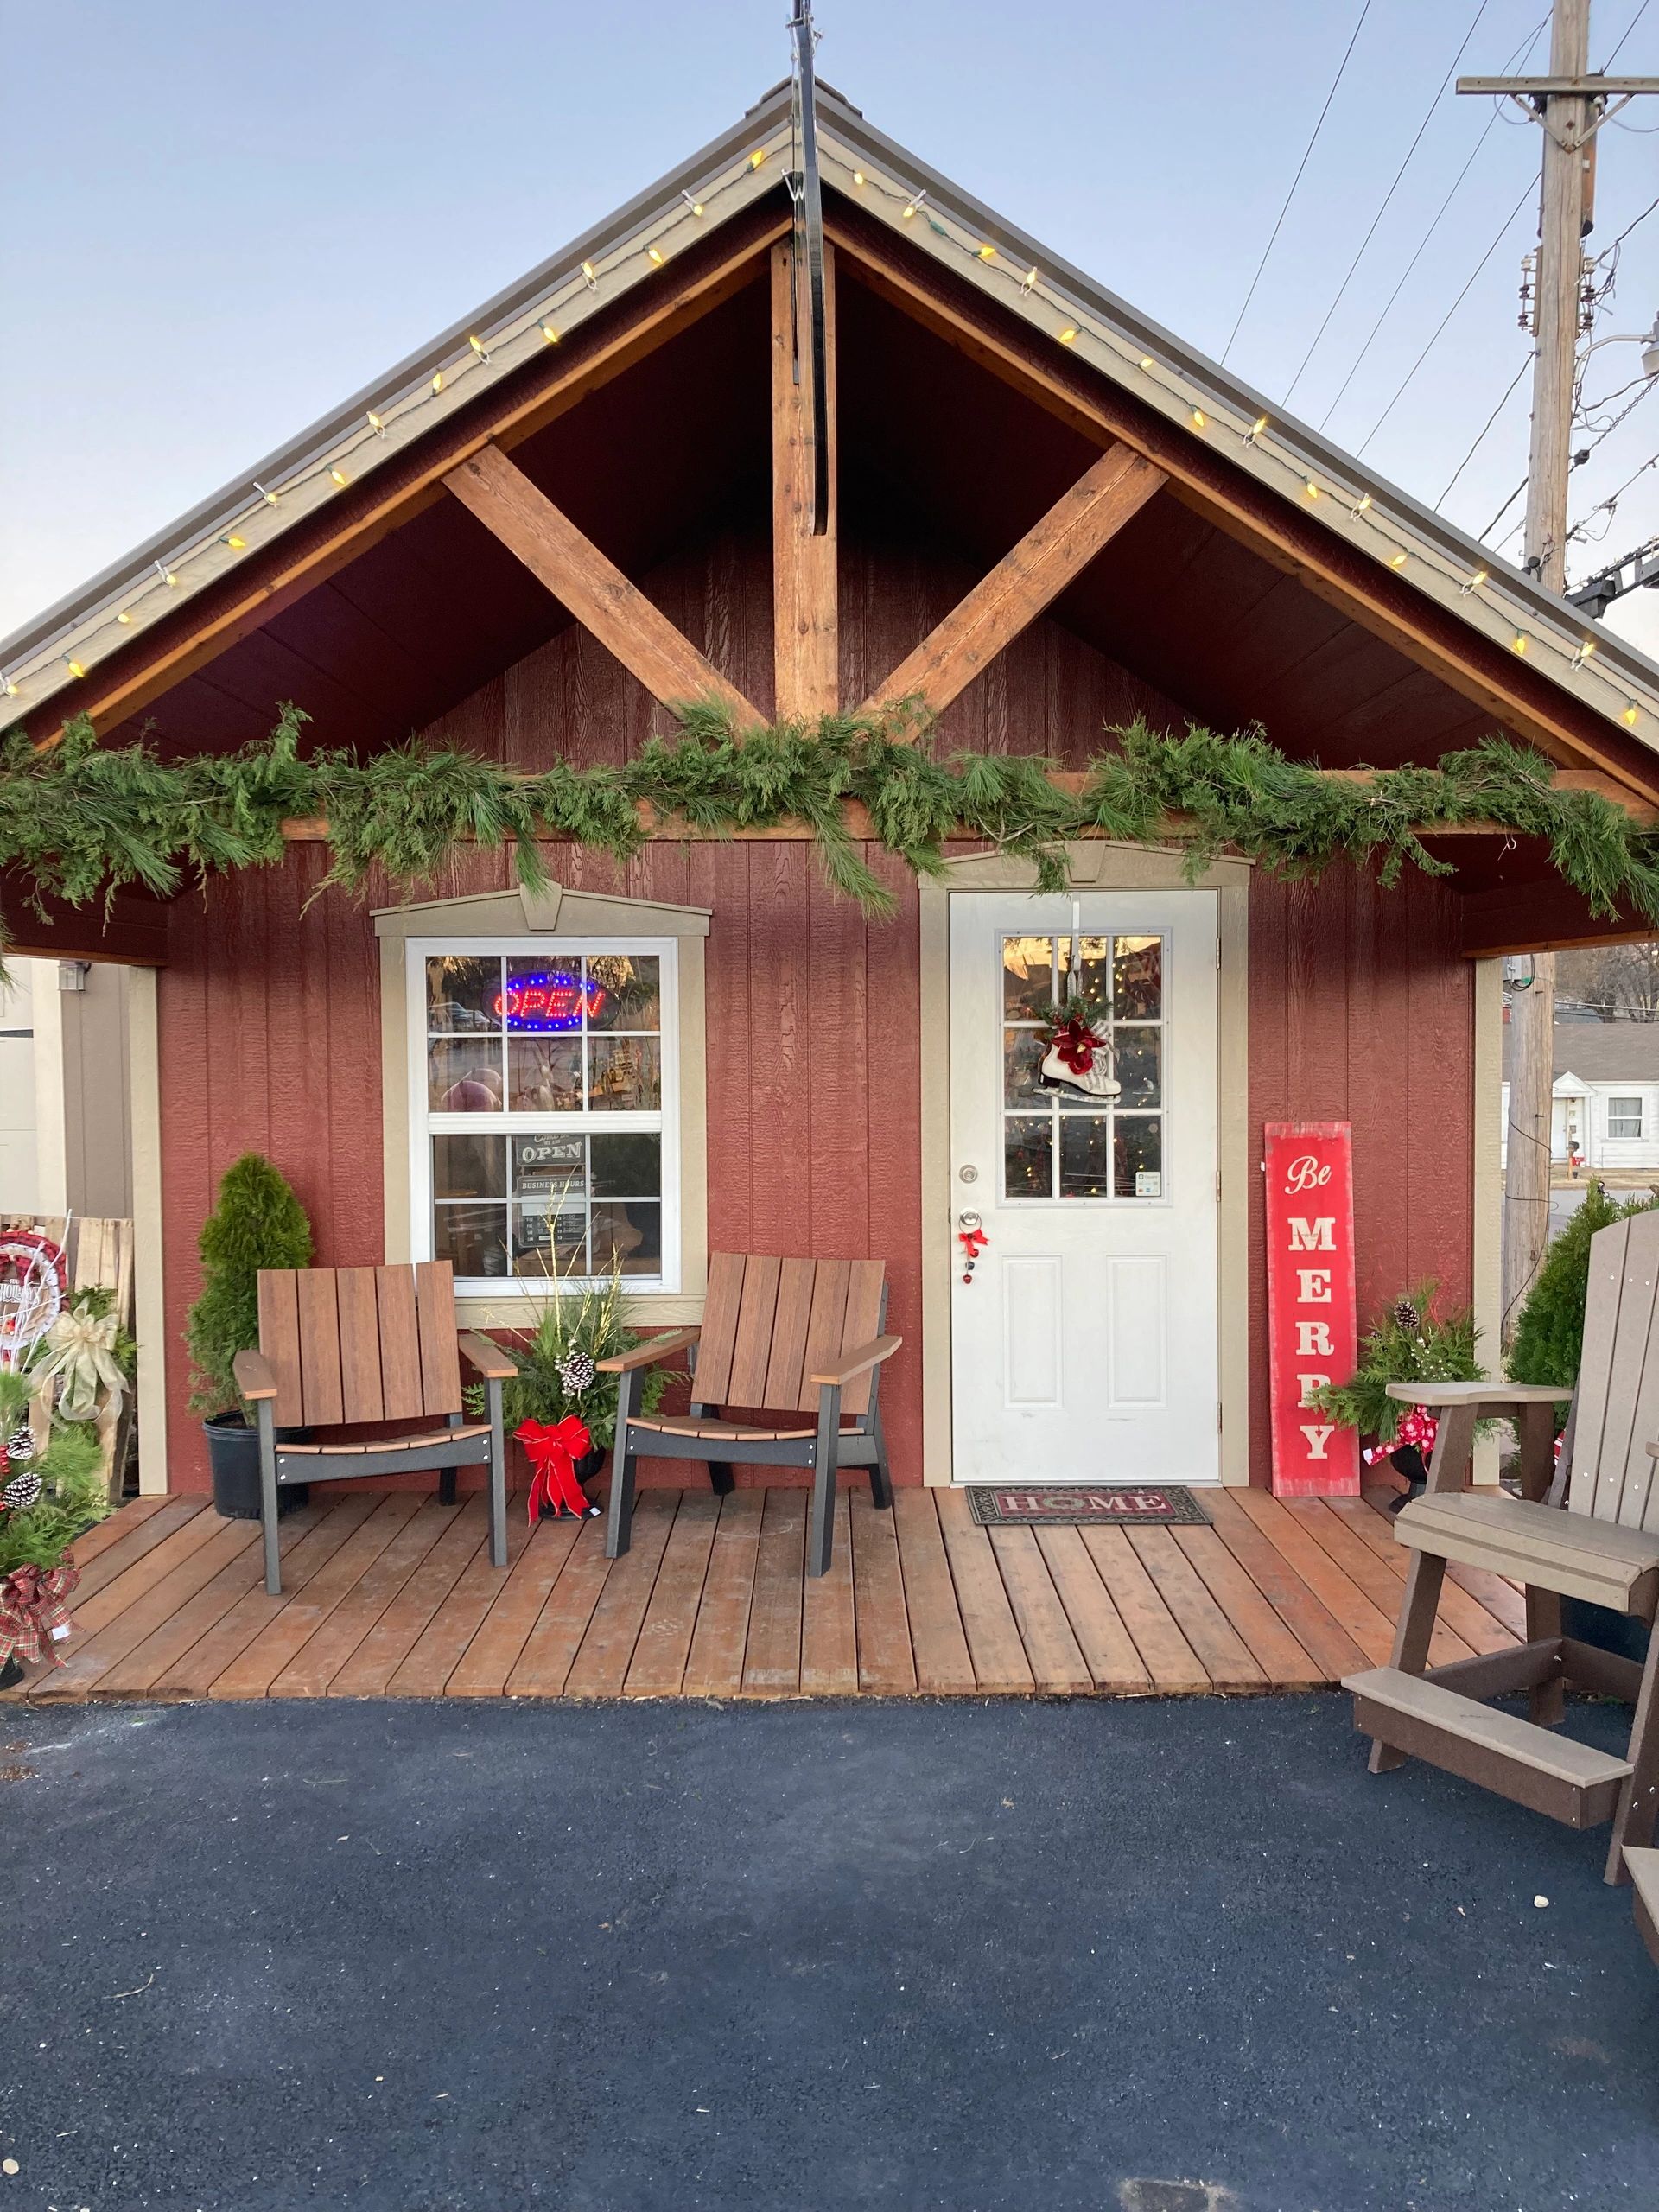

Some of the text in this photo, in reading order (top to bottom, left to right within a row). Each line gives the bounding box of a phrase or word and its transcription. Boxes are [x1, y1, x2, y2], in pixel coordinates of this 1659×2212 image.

[493, 990, 606, 1017] OPEN
[522, 1141, 583, 1163] OPEN
[559, 1180, 585, 1189] HURS
[1284, 1155, 1332, 1195] Be
